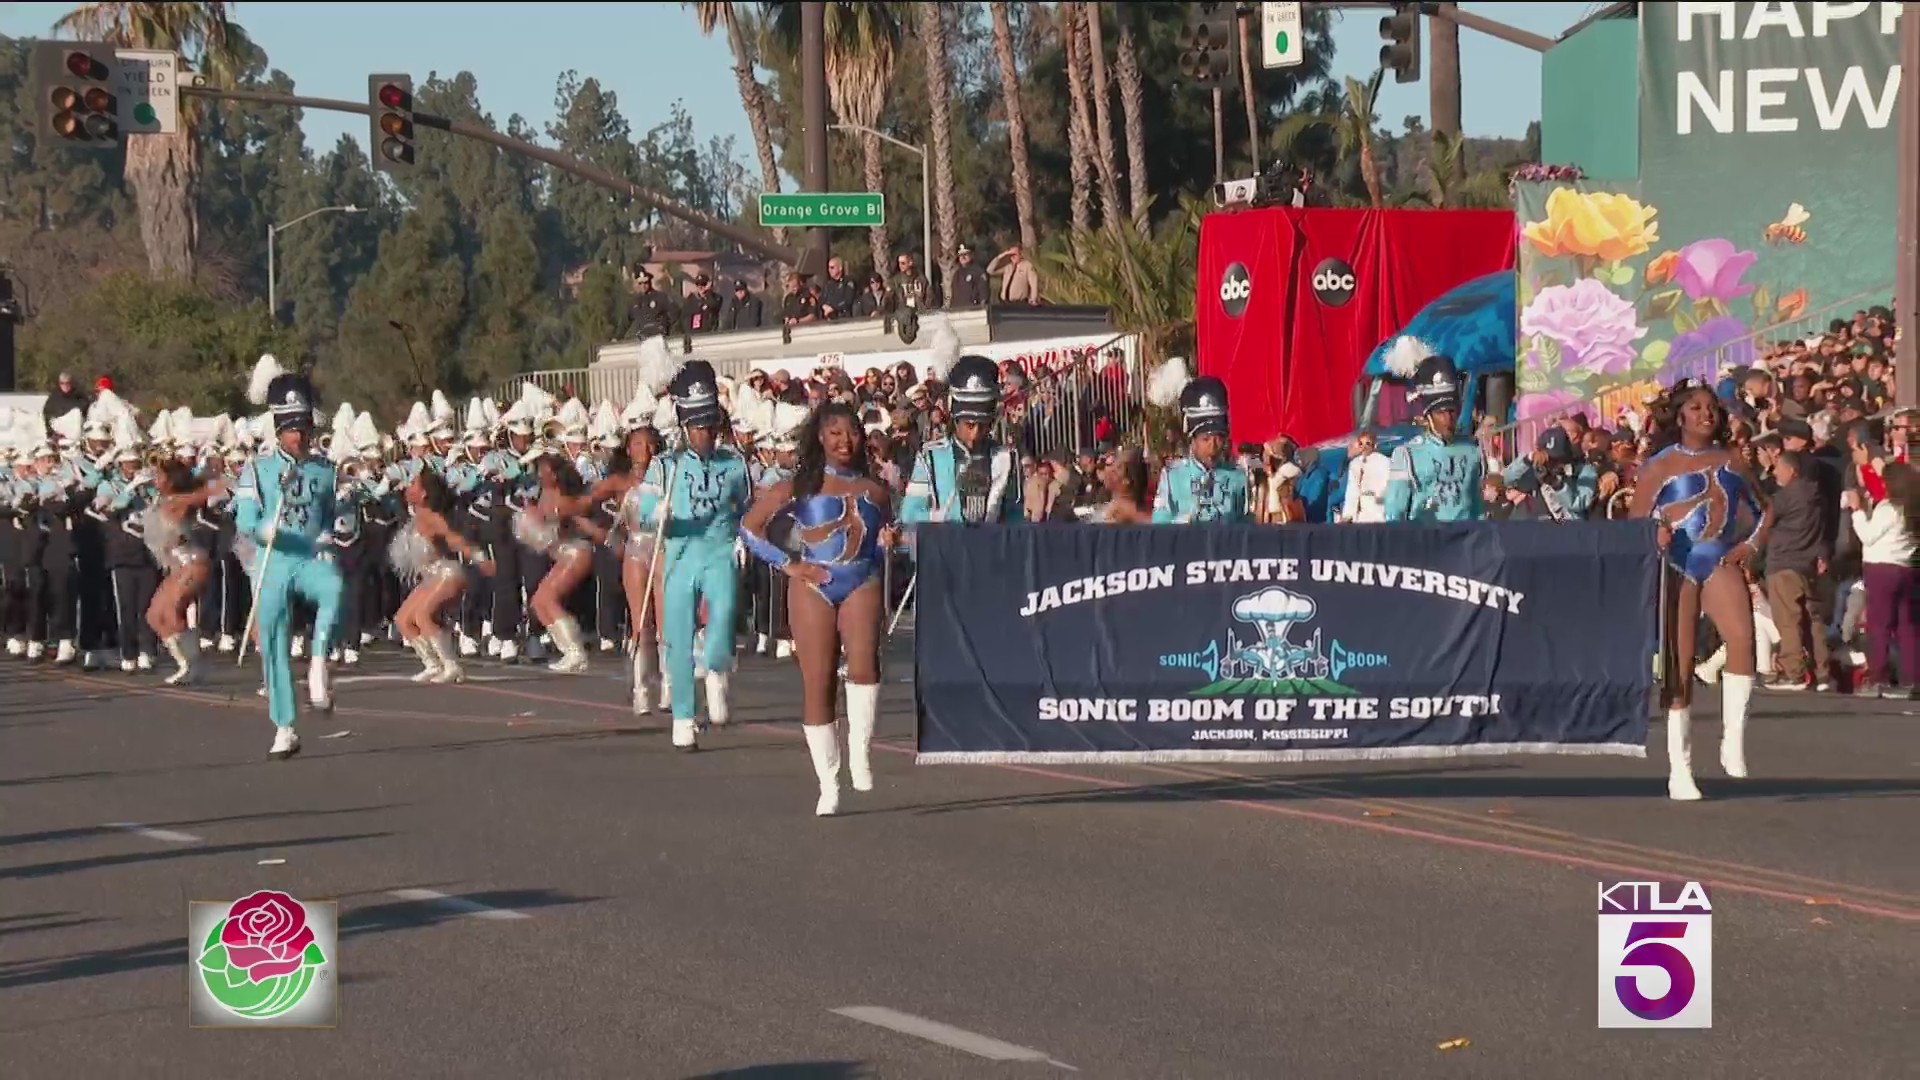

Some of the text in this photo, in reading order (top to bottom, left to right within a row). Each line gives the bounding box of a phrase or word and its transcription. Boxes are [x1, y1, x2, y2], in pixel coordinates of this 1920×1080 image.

[123, 71, 166, 83] YIELD
[1677, 65, 1901, 134] NEW
[763, 203, 812, 219] Orange
[820, 203, 859, 216] Grove
[1220, 274, 1250, 301] abc
[1313, 269, 1355, 291] abc
[1546, 436, 1555, 449] J
[1019, 559, 1524, 617] JACKSON STATE UNIVERSITY
[1160, 652, 1201, 667] SONIC
[1038, 694, 1500, 722] SONIC BOOM OF THE SOUTH
[1191, 728, 1349, 741] JACKSON, MISSISSIPPI
